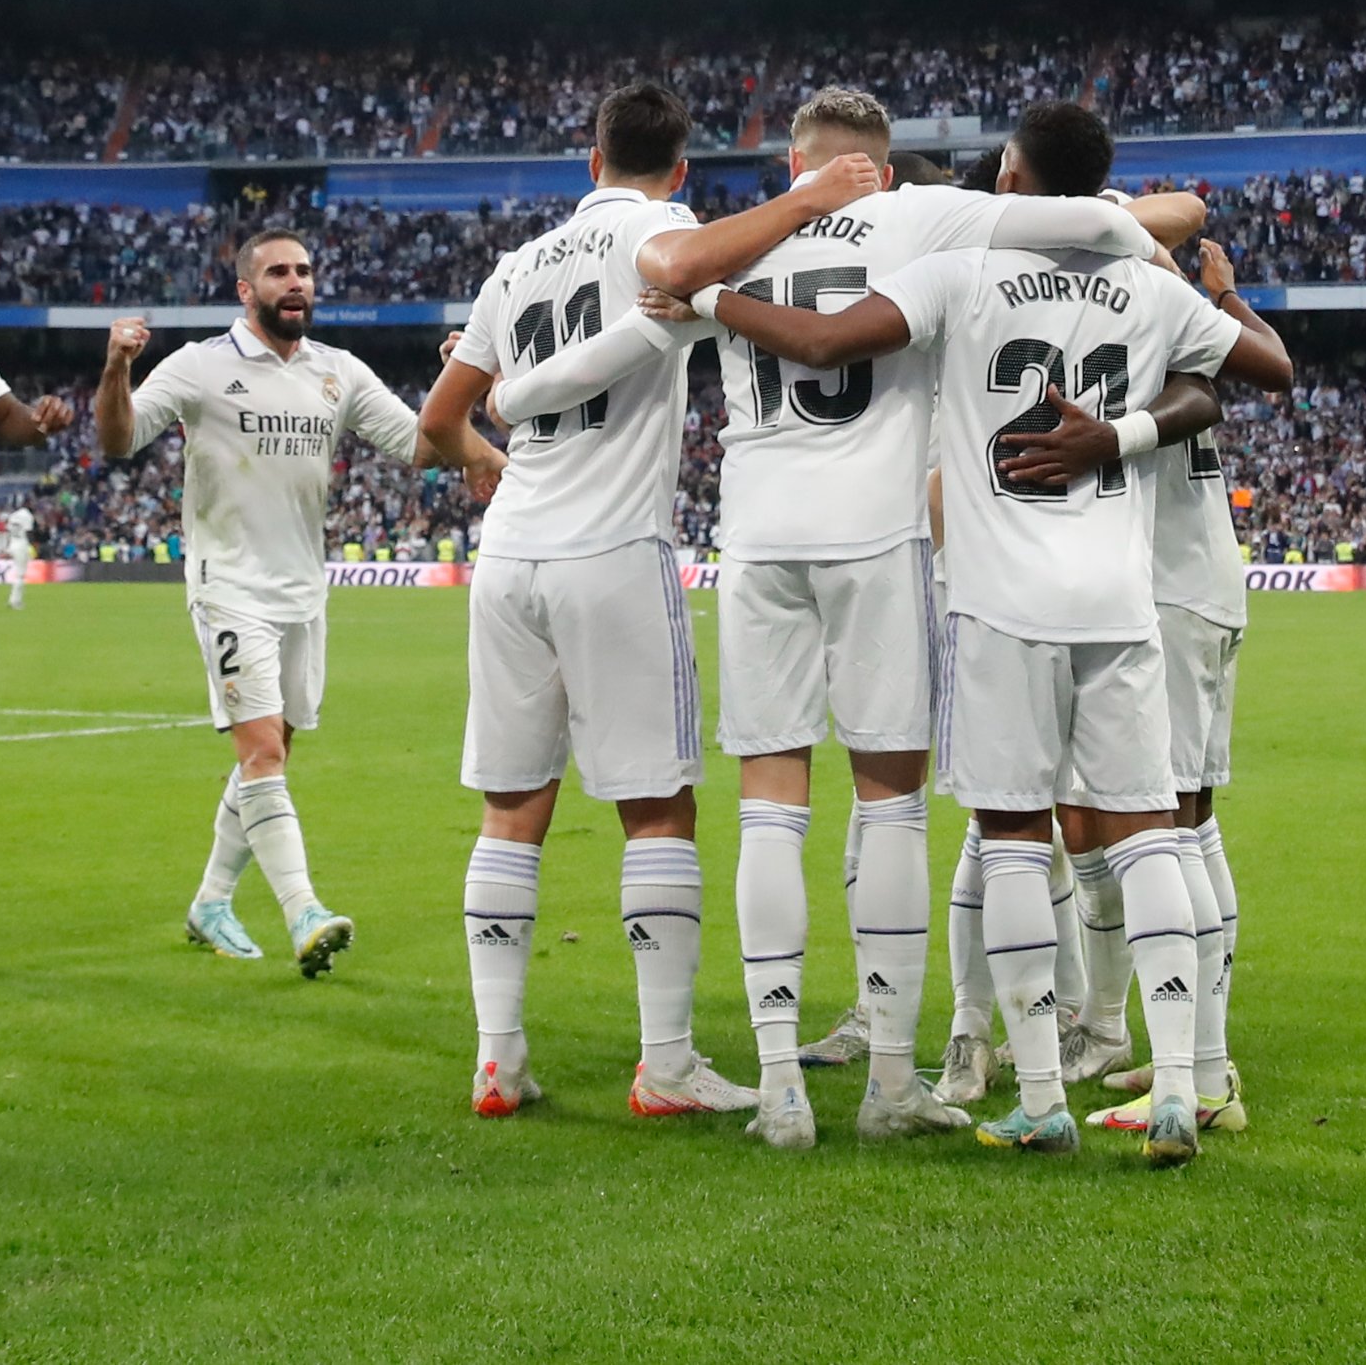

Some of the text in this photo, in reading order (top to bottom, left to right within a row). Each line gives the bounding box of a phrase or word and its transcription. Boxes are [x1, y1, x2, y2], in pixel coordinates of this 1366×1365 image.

[995, 270, 1131, 315] RODRYGO
[510, 281, 610, 443] 11
[728, 266, 874, 426] 15
[238, 411, 334, 435] Emirates
[986, 338, 1130, 503] 21
[257, 437, 323, 457] FLY BETTER
[217, 630, 240, 677] 2
[1150, 991, 1194, 1003] adidas
